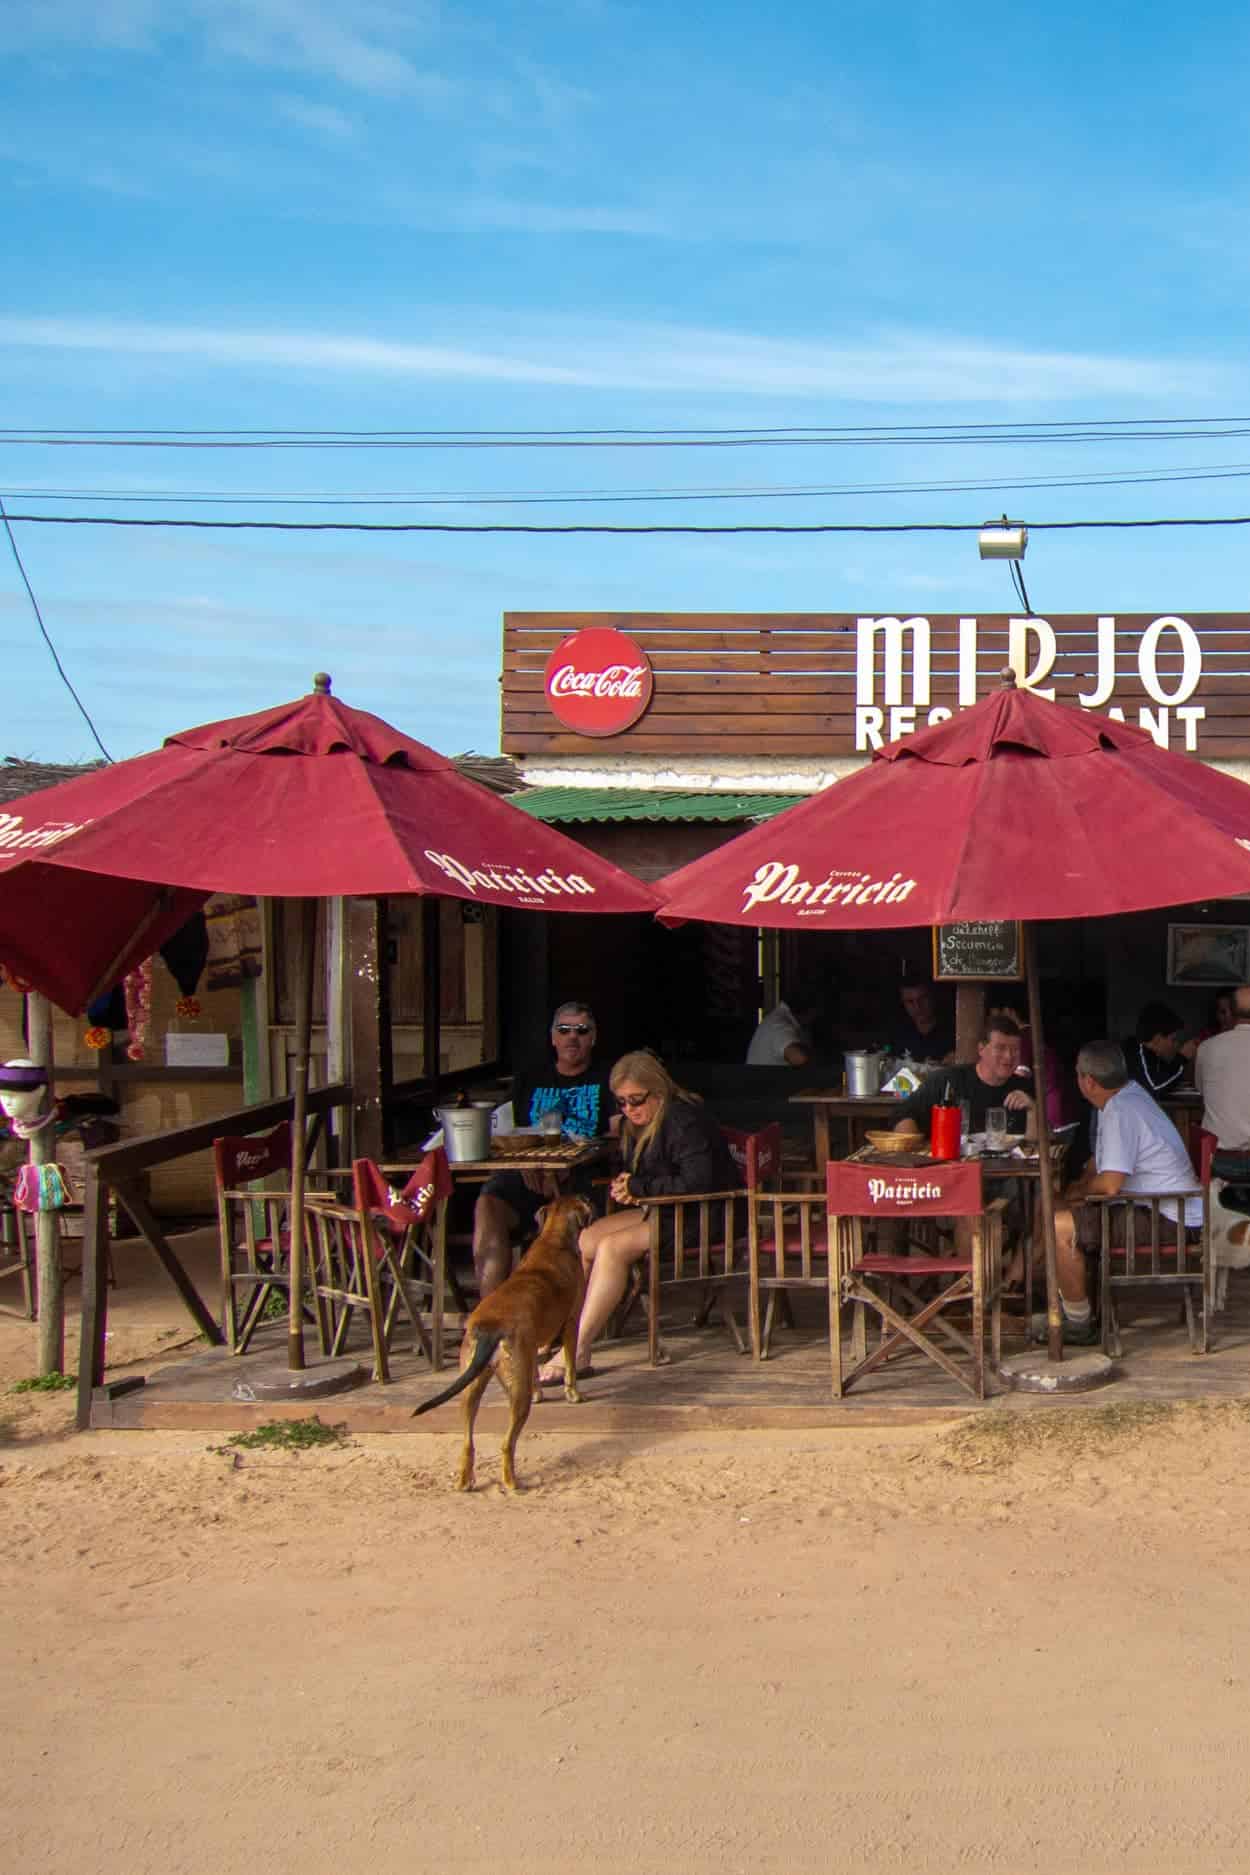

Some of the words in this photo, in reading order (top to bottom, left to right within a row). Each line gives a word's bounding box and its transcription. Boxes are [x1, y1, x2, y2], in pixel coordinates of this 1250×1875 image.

[550, 664, 647, 697] Coca-Cola
[424, 849, 595, 895] Patricia
[742, 861, 917, 913] Patricia
[868, 1178, 941, 1204] Patricia
